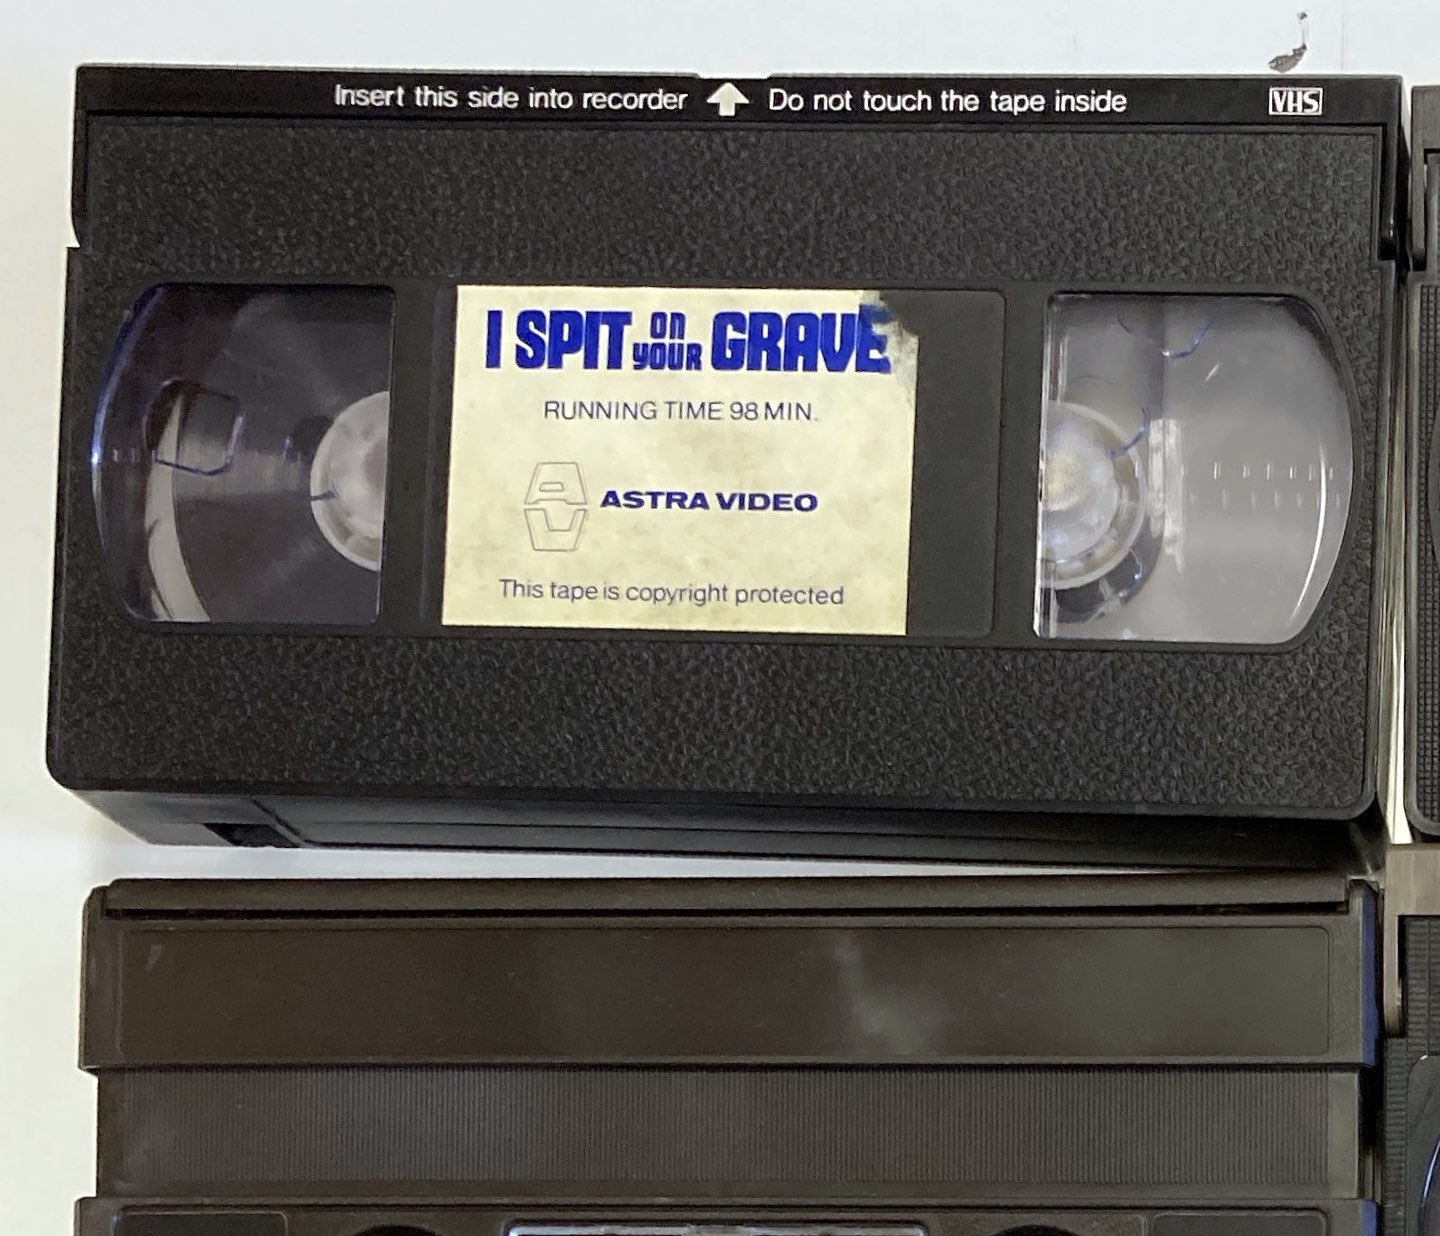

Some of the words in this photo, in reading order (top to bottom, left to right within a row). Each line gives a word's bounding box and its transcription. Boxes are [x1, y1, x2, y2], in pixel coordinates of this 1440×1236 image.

[335, 84, 405, 106] Insert
[415, 86, 458, 107] this
[468, 86, 519, 108] side
[529, 87, 573, 108] into
[583, 88, 688, 110] recorder
[769, 88, 804, 111] Do
[814, 90, 852, 110] not
[863, 90, 932, 111] touch
[941, 89, 979, 111] the
[990, 91, 1045, 115] tape
[1055, 89, 1127, 112] inside
[1271, 89, 1321, 113] VHS
[485, 309, 504, 369] I
[515, 309, 632, 370] SPIT
[711, 304, 893, 374] GRAVE
[545, 401, 657, 420] RUNNING
[664, 401, 724, 420] TIME
[730, 402, 758, 421] 98
[765, 402, 817, 421] MIN.
[600, 491, 710, 510] ASTRA
[716, 492, 817, 512] VIDEO
[499, 579, 543, 598] This
[550, 582, 598, 603] tape
[603, 586, 620, 600] is
[626, 583, 728, 607] copyright
[735, 586, 844, 606] protected
